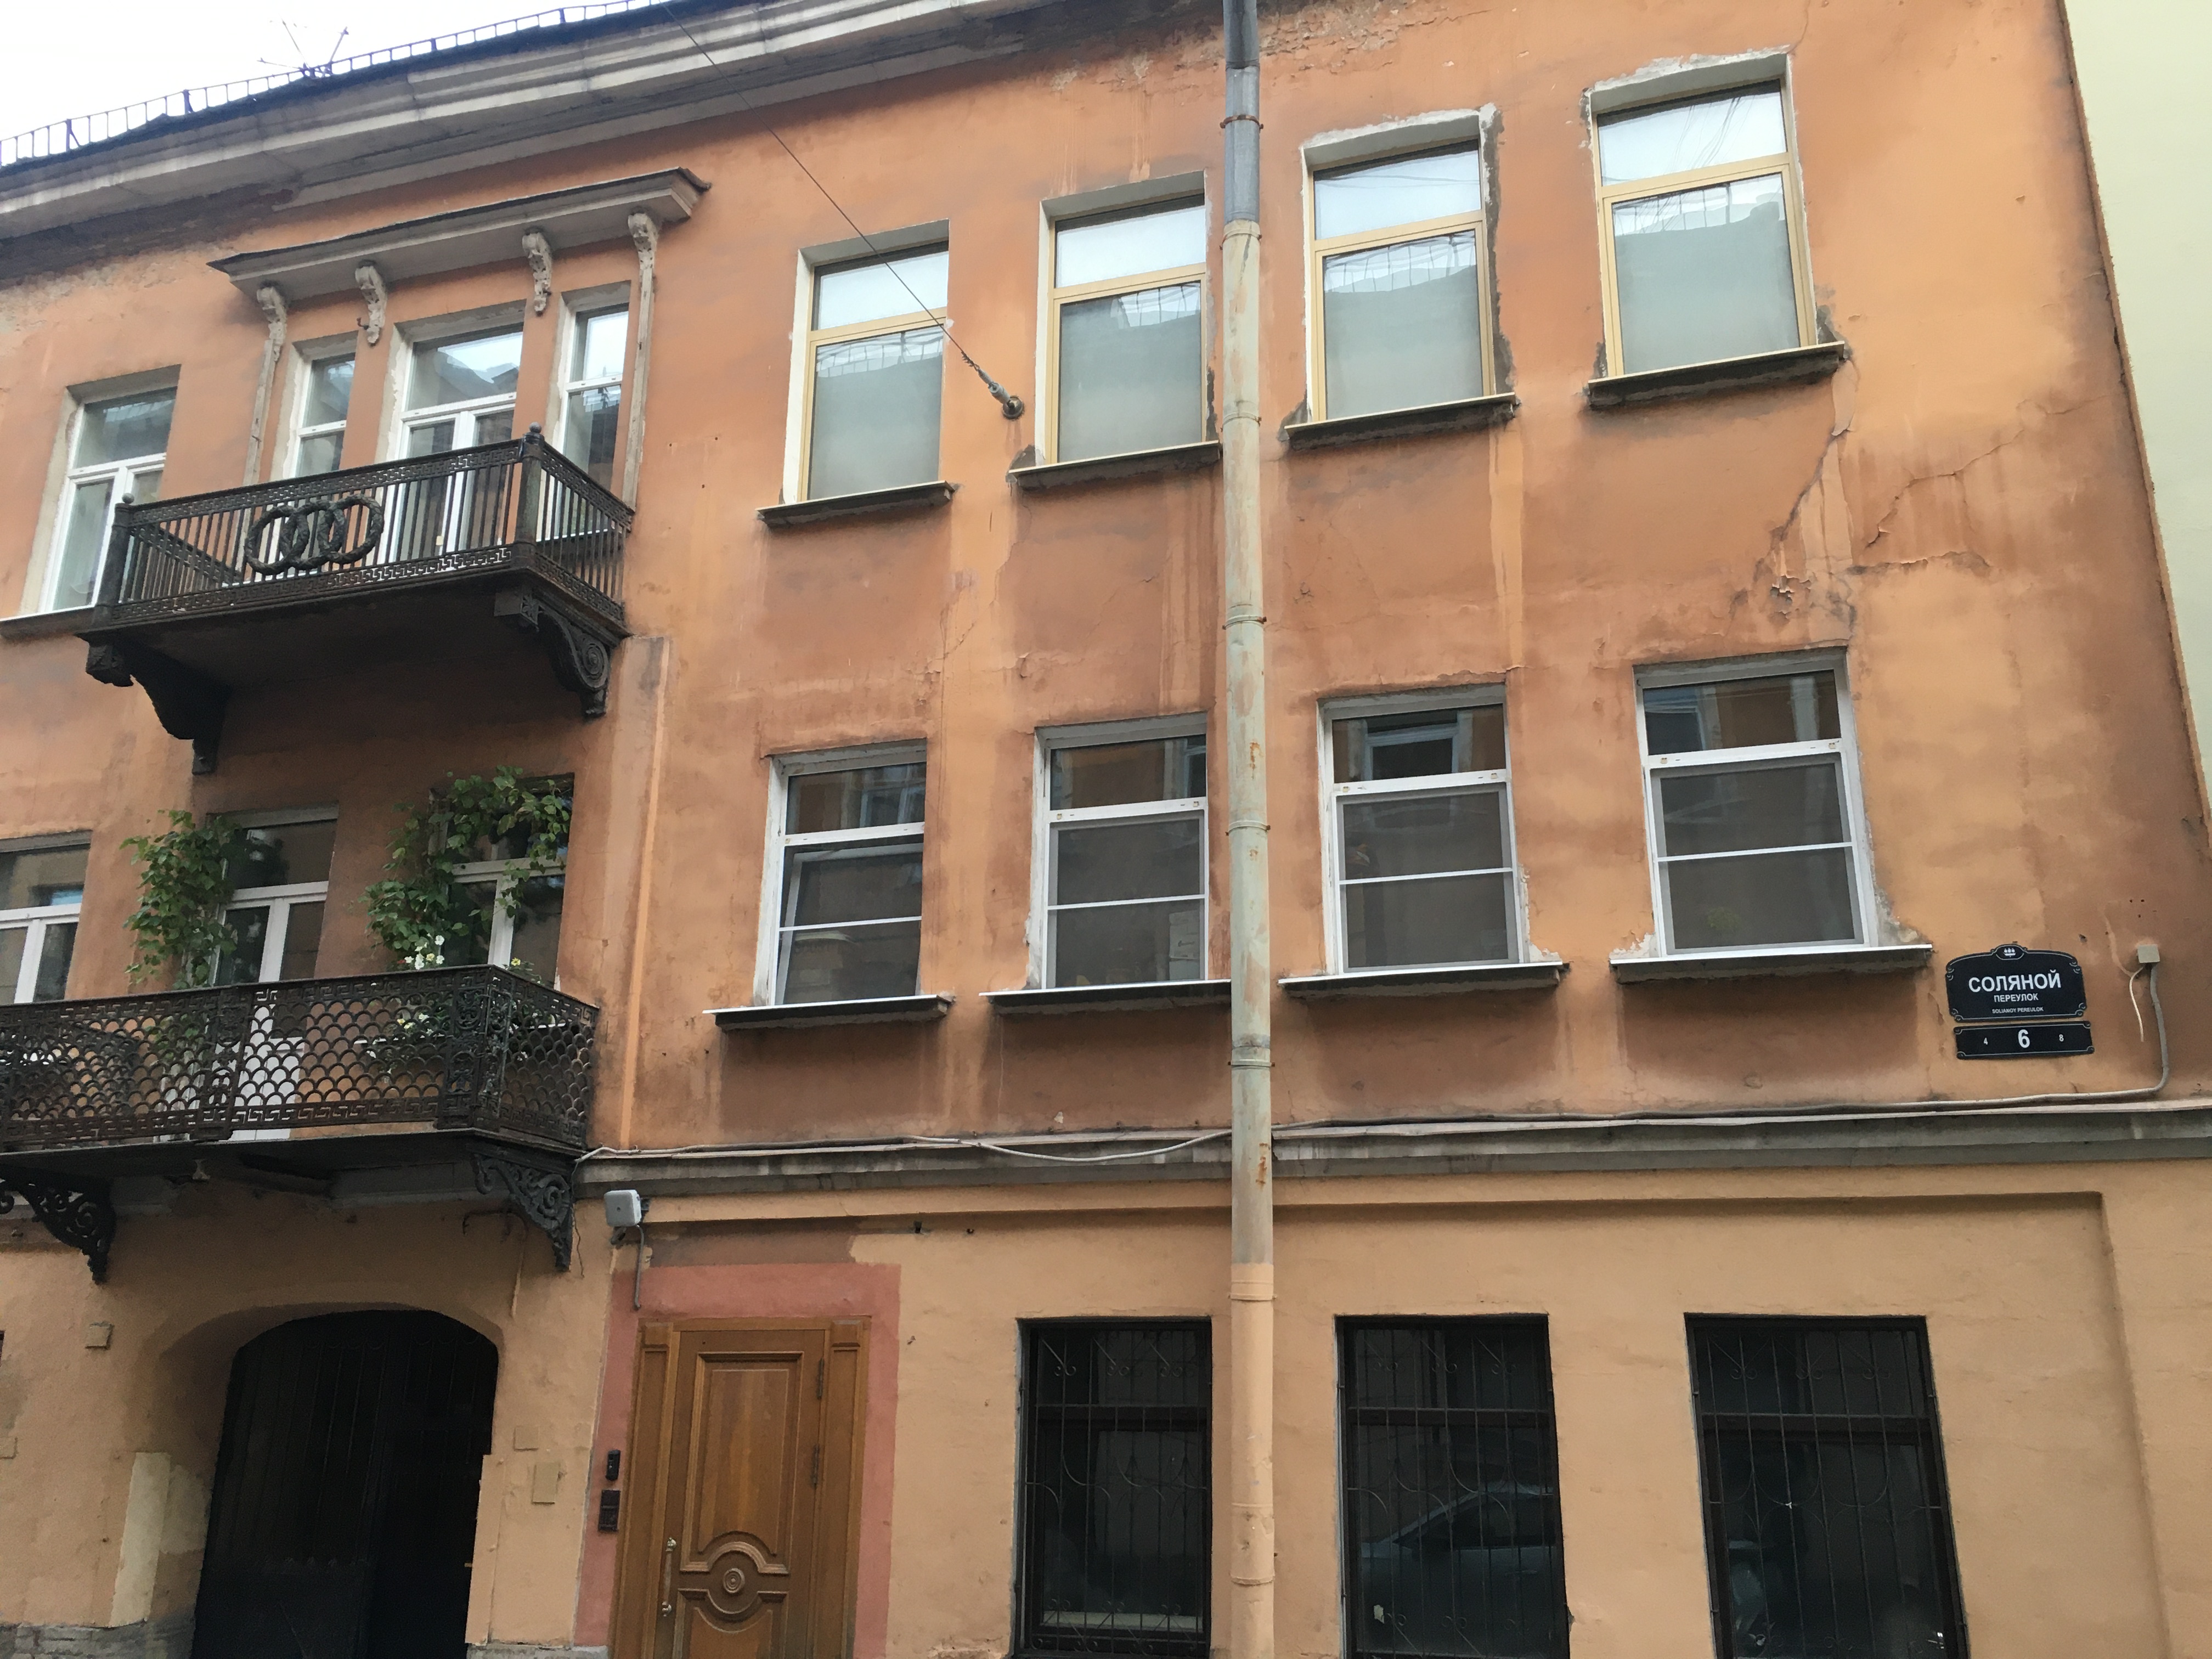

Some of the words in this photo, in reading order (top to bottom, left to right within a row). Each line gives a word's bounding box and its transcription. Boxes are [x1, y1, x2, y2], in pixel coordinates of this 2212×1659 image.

[1968, 969, 2061, 992] СОЛЯНОЙ
[1994, 993, 2039, 1002] ПЕРЕУЛОК
[2018, 1029, 2030, 1048] 6
